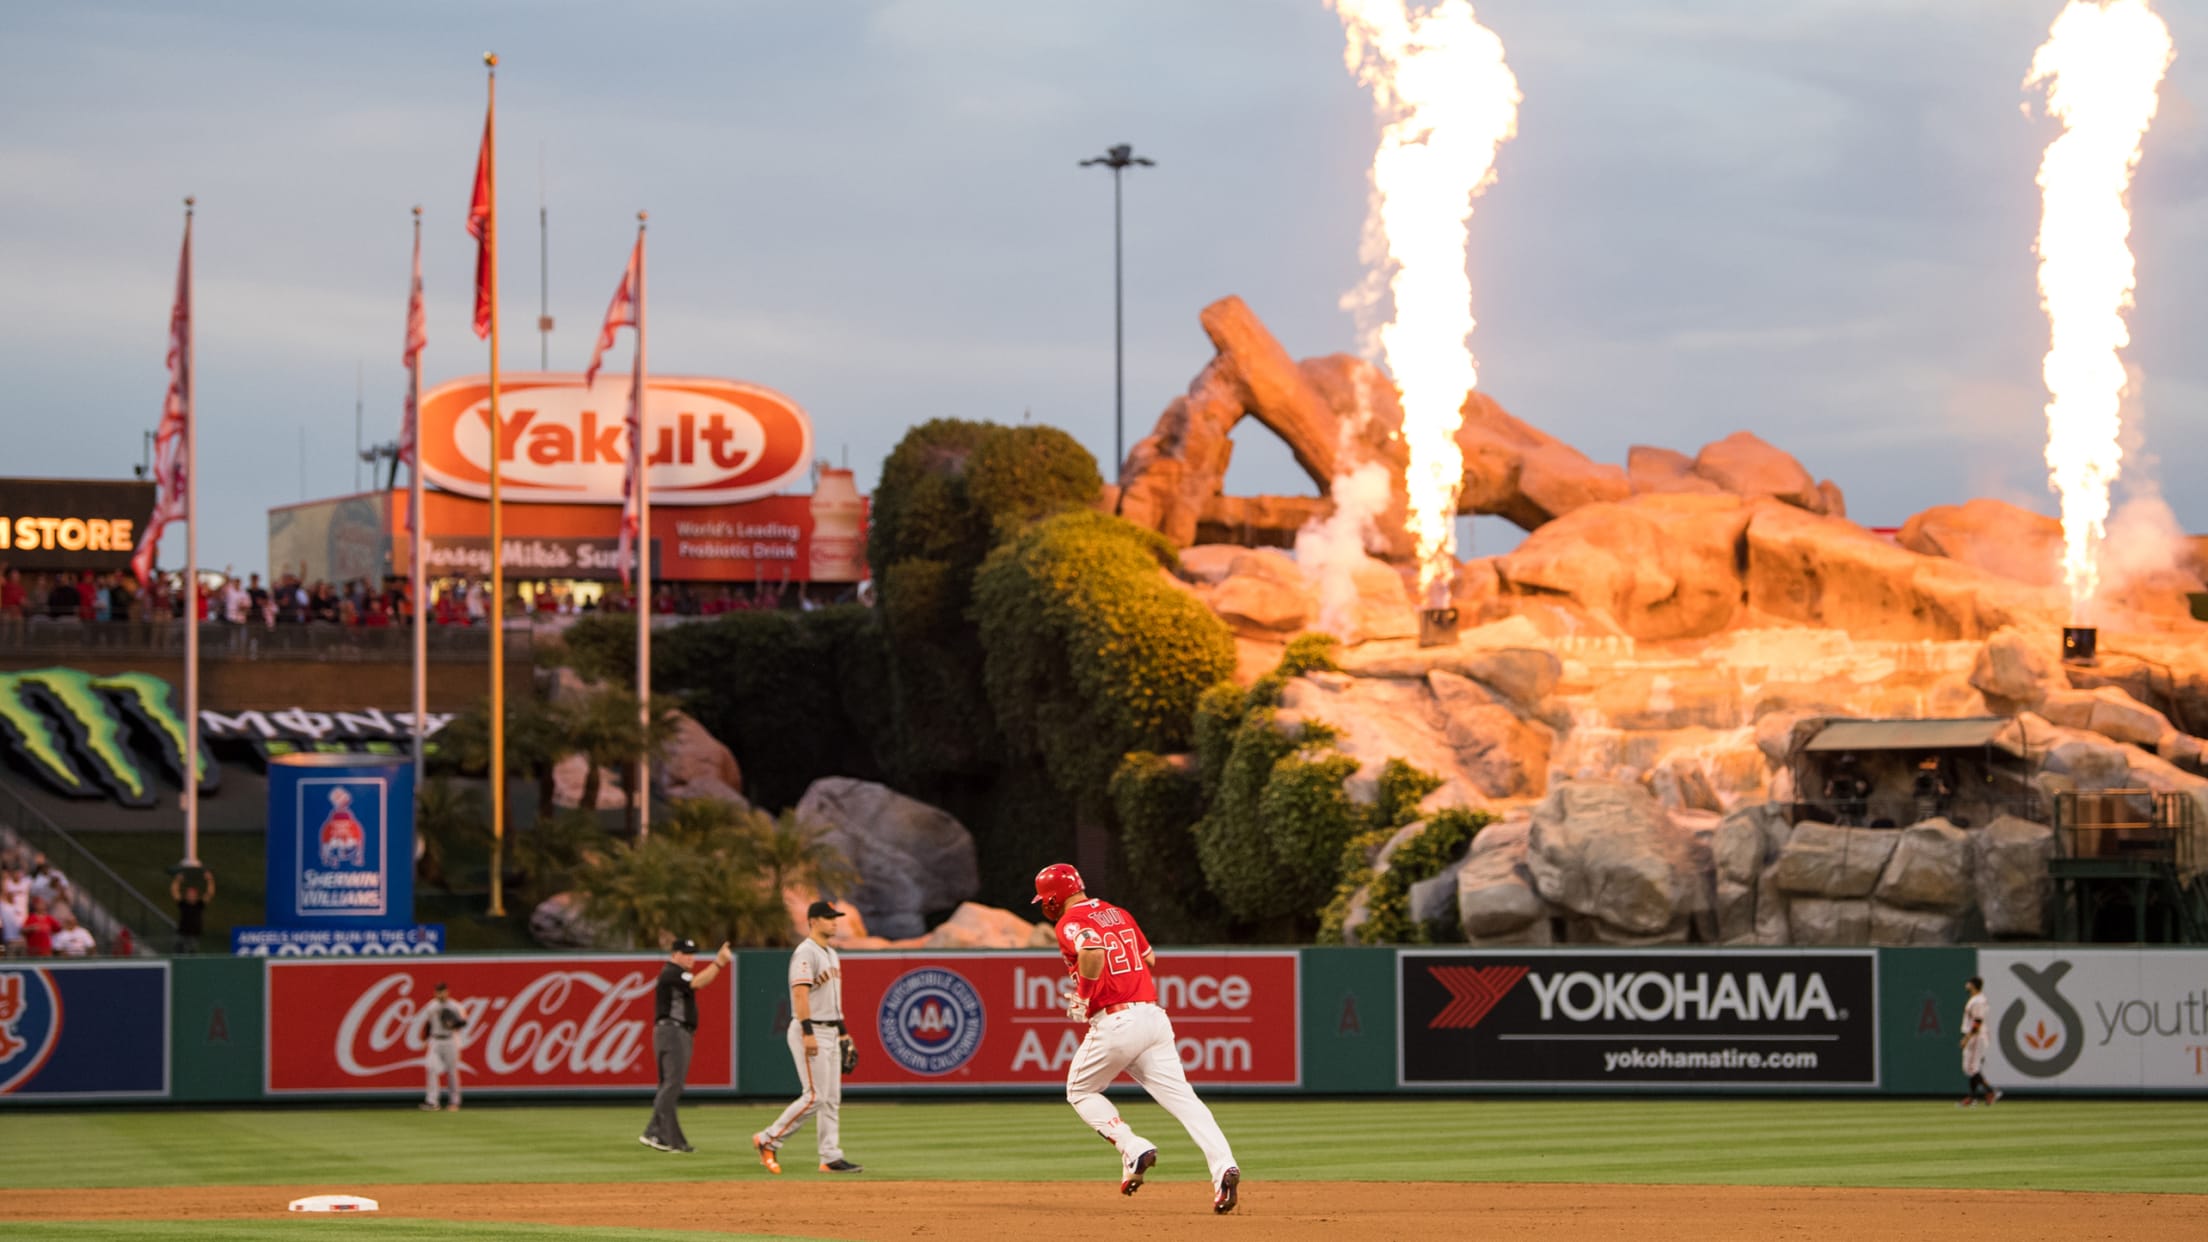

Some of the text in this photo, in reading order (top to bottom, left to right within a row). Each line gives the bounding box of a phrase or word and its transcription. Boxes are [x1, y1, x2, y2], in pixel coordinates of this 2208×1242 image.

[476, 409, 748, 470] Yakult
[15, 516, 134, 551] STORE
[676, 521, 799, 540] World's Leading
[679, 543, 749, 558] Probiotic
[753, 544, 798, 559] Drink
[1088, 907, 1126, 928] TROUT
[381, 929, 404, 942] THE
[1104, 929, 1143, 975] 27
[1013, 966, 1252, 1010] Insnce
[1527, 971, 1839, 1022] YOKOHAMA
[335, 970, 660, 1077] Coca-Cola
[907, 1003, 956, 1033] AAA
[1010, 1028, 1253, 1071] AAom
[1604, 1048, 1819, 1072] yokohamatire.com
